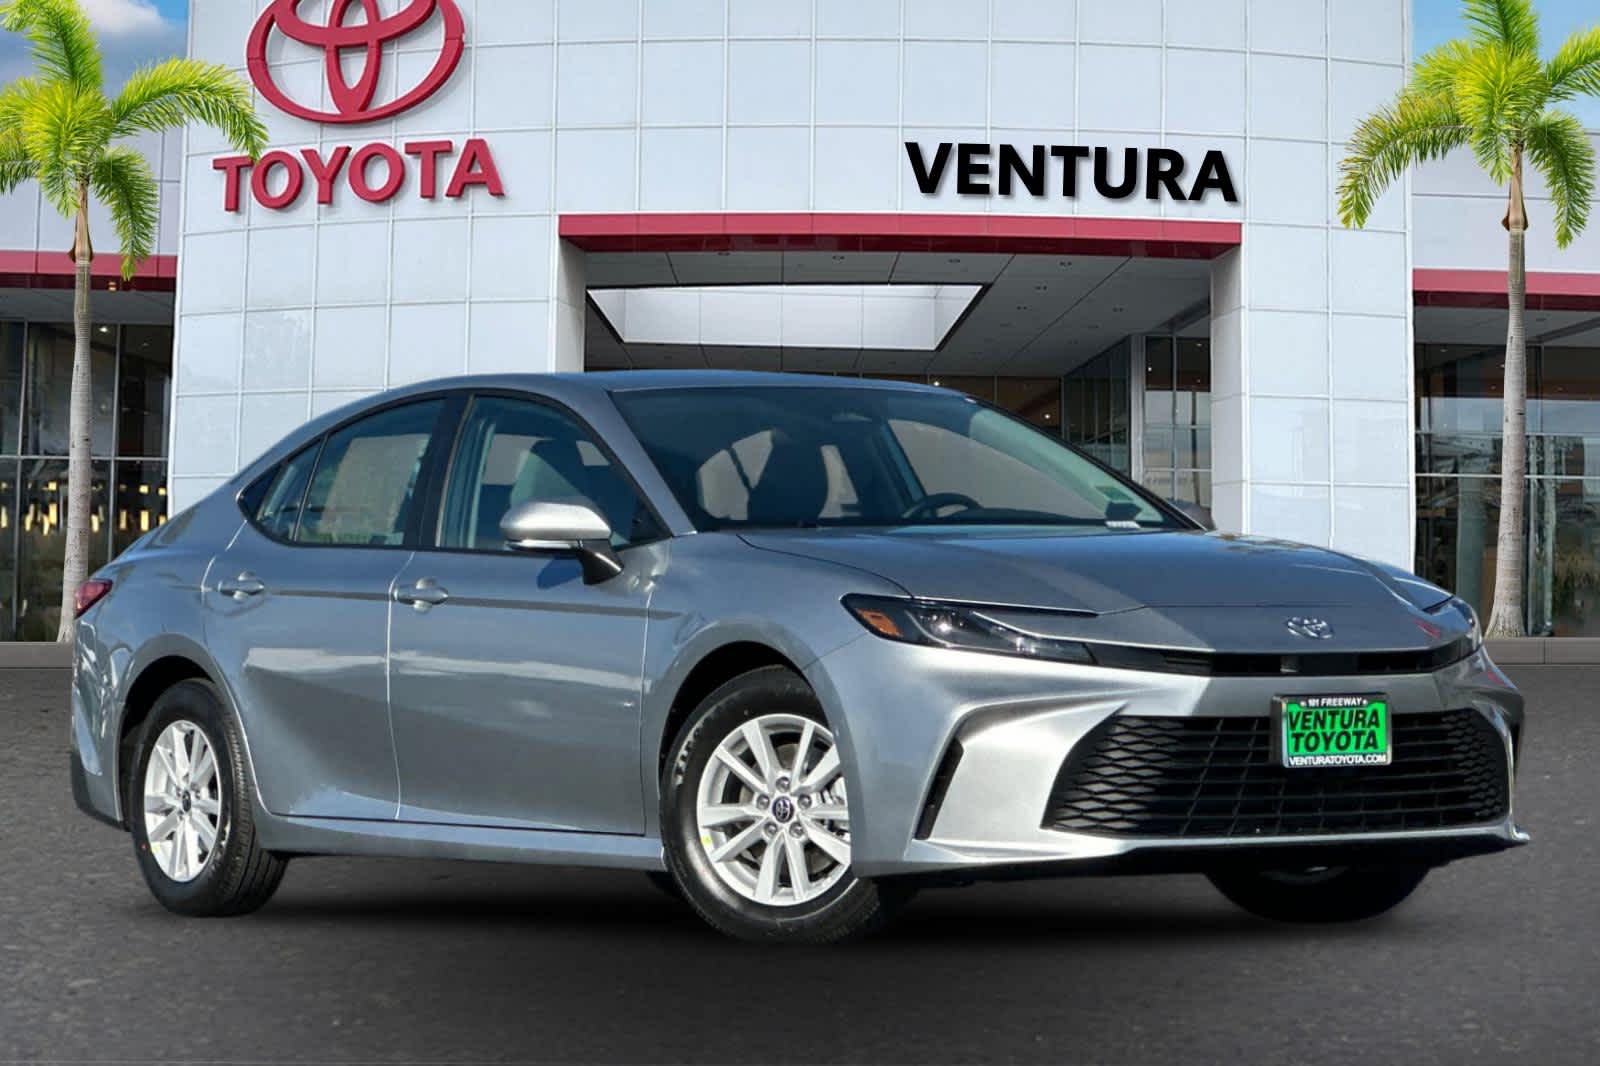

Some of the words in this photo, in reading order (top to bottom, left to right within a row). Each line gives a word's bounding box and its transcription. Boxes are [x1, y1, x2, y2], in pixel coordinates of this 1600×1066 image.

[213, 138, 505, 212] TOYOTA
[905, 142, 1238, 202] VENTURA
[1321, 697, 1362, 706] FREEWAY
[1289, 708, 1380, 730] VENTURA
[1291, 730, 1378, 752] TOYOTA
[1289, 754, 1386, 765] VENTURATOYOTA.COM
